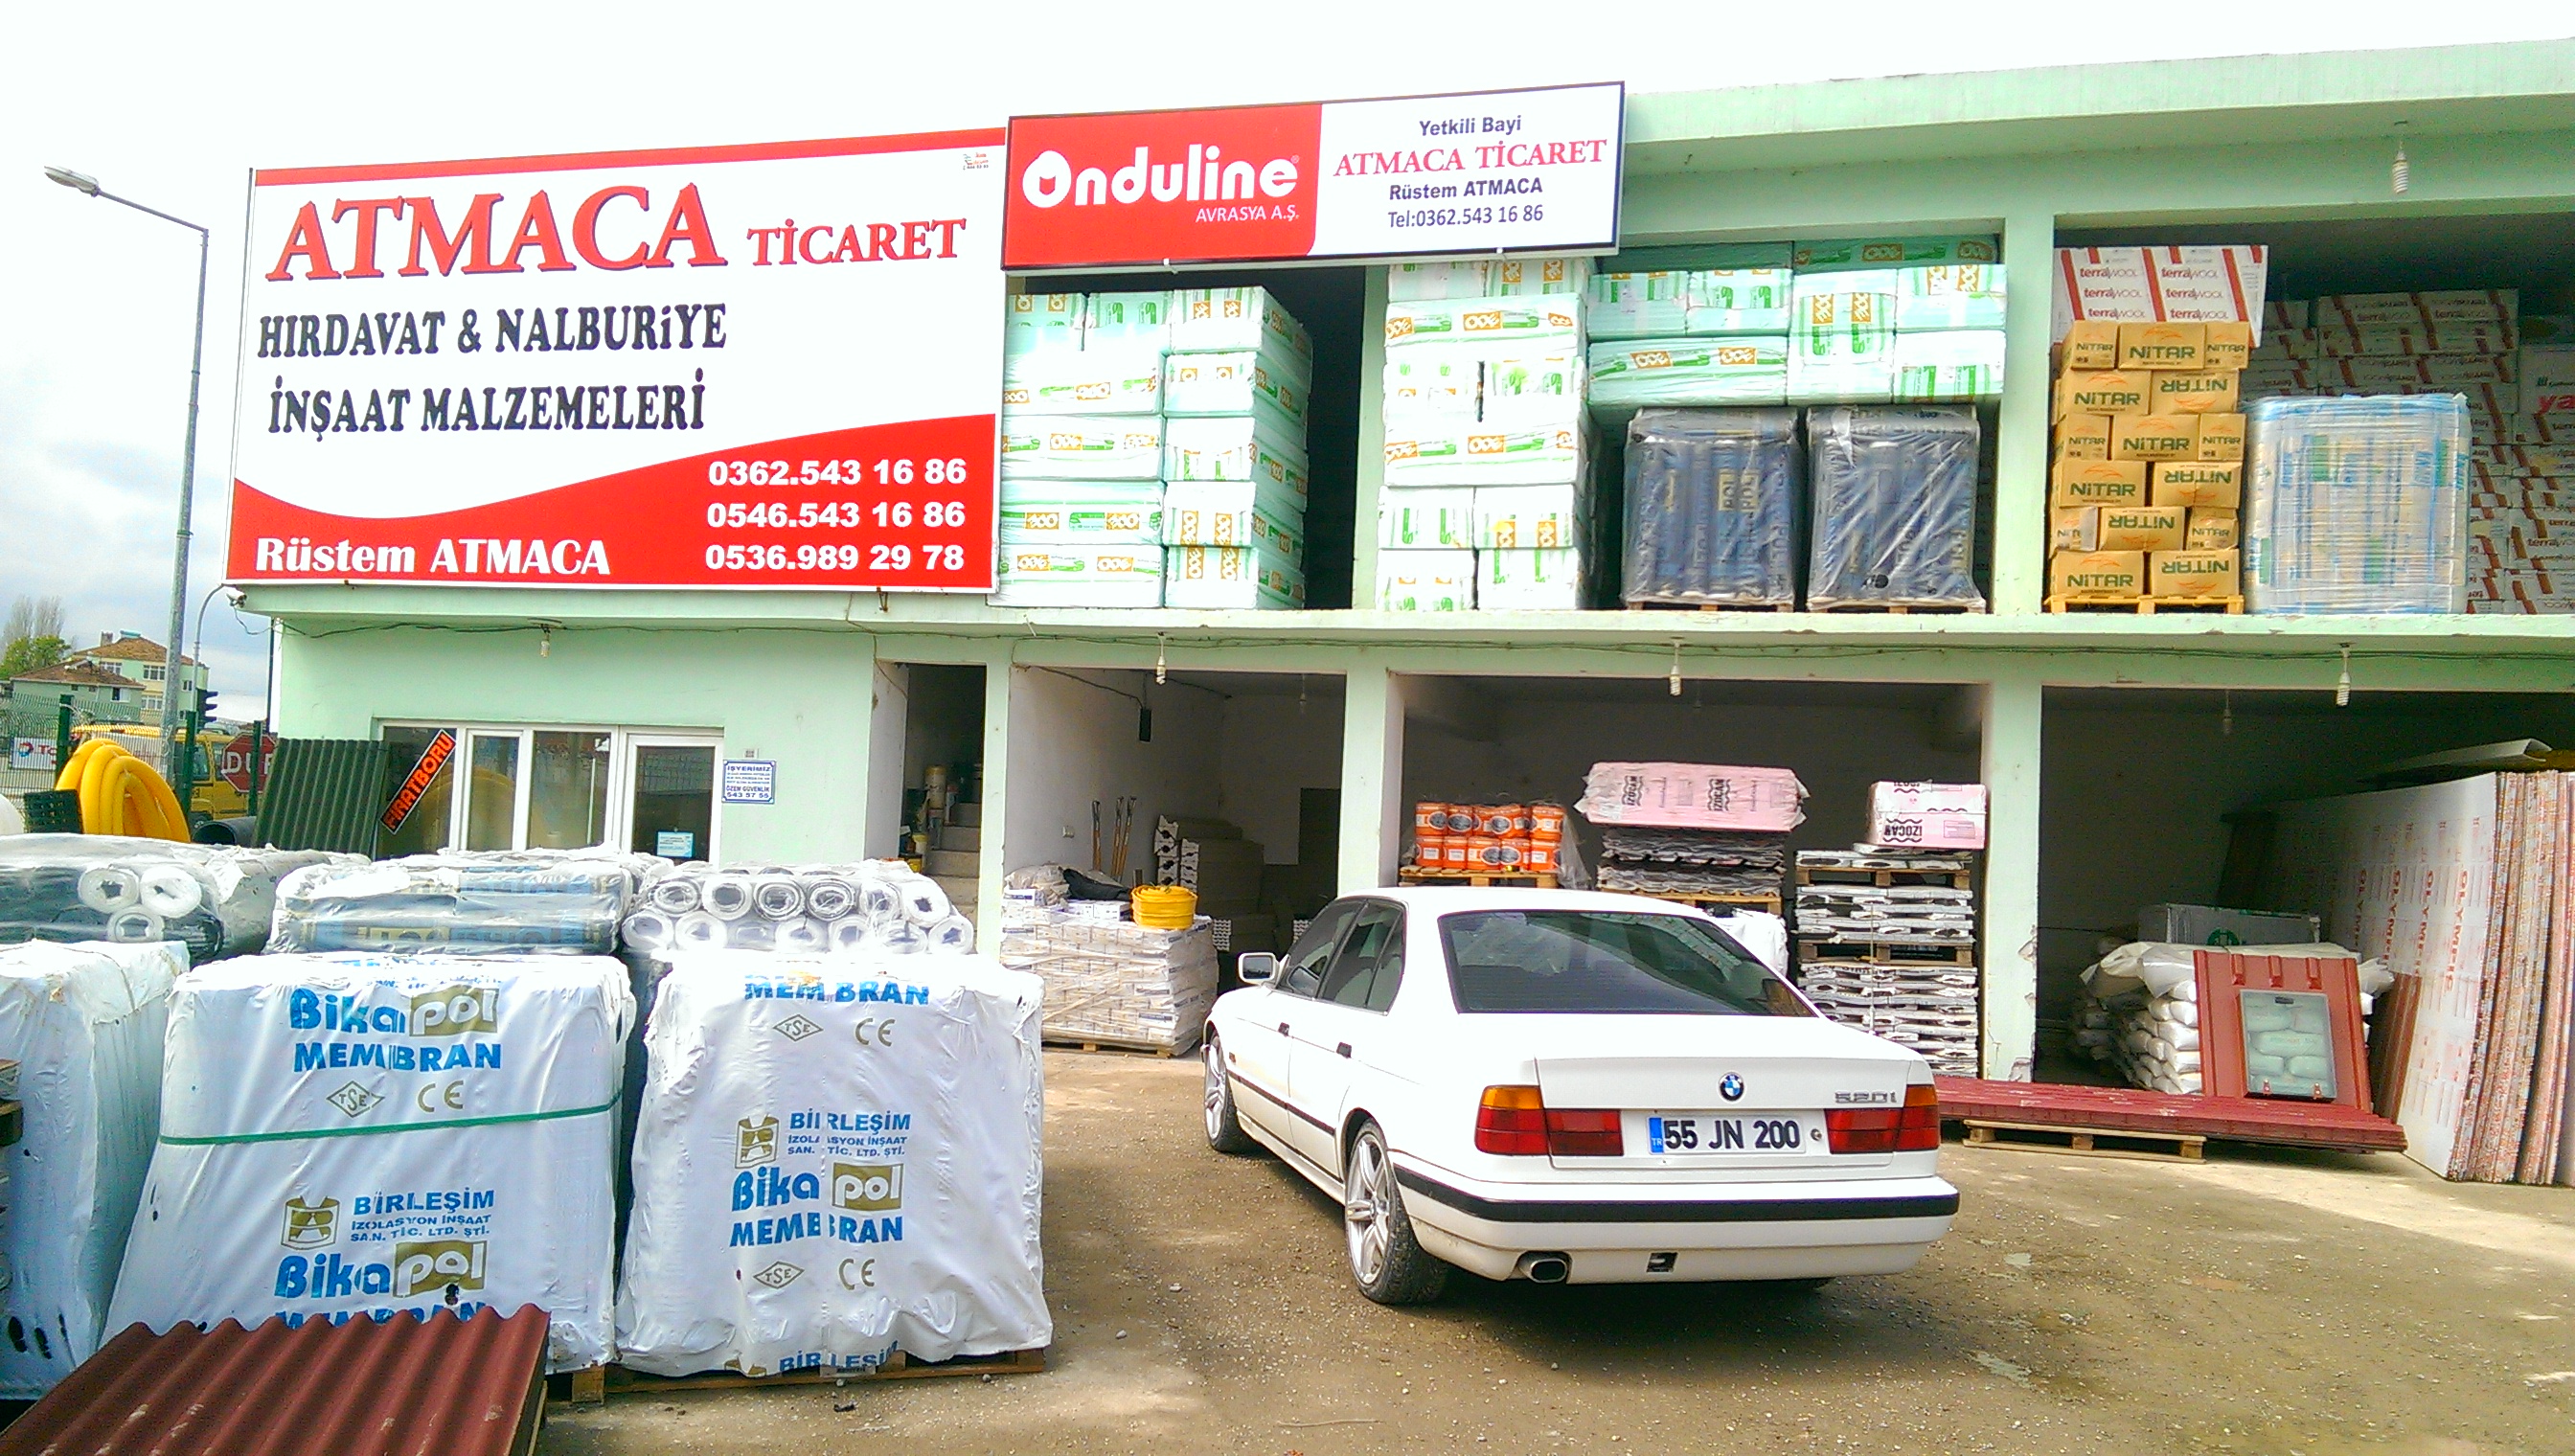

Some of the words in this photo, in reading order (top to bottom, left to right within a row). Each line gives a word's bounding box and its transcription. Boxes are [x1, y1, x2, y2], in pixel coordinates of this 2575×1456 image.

[1419, 117, 1476, 137] Yetkili
[1483, 115, 1521, 136] Bayi
[1333, 148, 1466, 177] ATMACA
[1476, 139, 1607, 170] TİCARET
[1022, 144, 1298, 208] Onduline
[1389, 181, 1457, 201] Rüstem
[1464, 177, 1543, 196] ATMACA
[1196, 205, 1266, 223] AVRASYA
[1270, 204, 1300, 223] A.Ş.
[1388, 207, 1492, 228] Tel:0362.543
[1498, 205, 1518, 224] 16
[1522, 204, 1544, 223] 86
[266, 182, 729, 282] ATMACA
[747, 217, 967, 266] TİCARET
[258, 311, 445, 359] HIRDAVAT
[457, 309, 482, 353] &
[268, 375, 411, 442] İNŞAAT
[421, 367, 705, 434] MALZEMELERİ
[709, 459, 861, 488] 0362.543
[874, 459, 914, 486] 16
[923, 458, 967, 486] 86
[707, 501, 860, 530] 0546.543
[873, 502, 913, 529] 16
[923, 501, 966, 528] 86
[256, 536, 416, 575] Rüstem
[429, 538, 611, 576] ATMACA
[705, 544, 858, 573] 0536.989
[871, 544, 913, 572] 29
[922, 544, 965, 571] 78
[293, 1042, 502, 1073] MEMBRAN
[867, 1135, 907, 1147] İNŞAAT
[1663, 1120, 1698, 1149] 55
[1708, 1120, 1743, 1149] JN
[1753, 1120, 1801, 1149] 200
[787, 1146, 815, 1155] SAN.
[353, 1187, 495, 1215] BİRLEŞİM
[428, 1226, 458, 1237] LTD.
[442, 1214, 492, 1226] İNŞAAT
